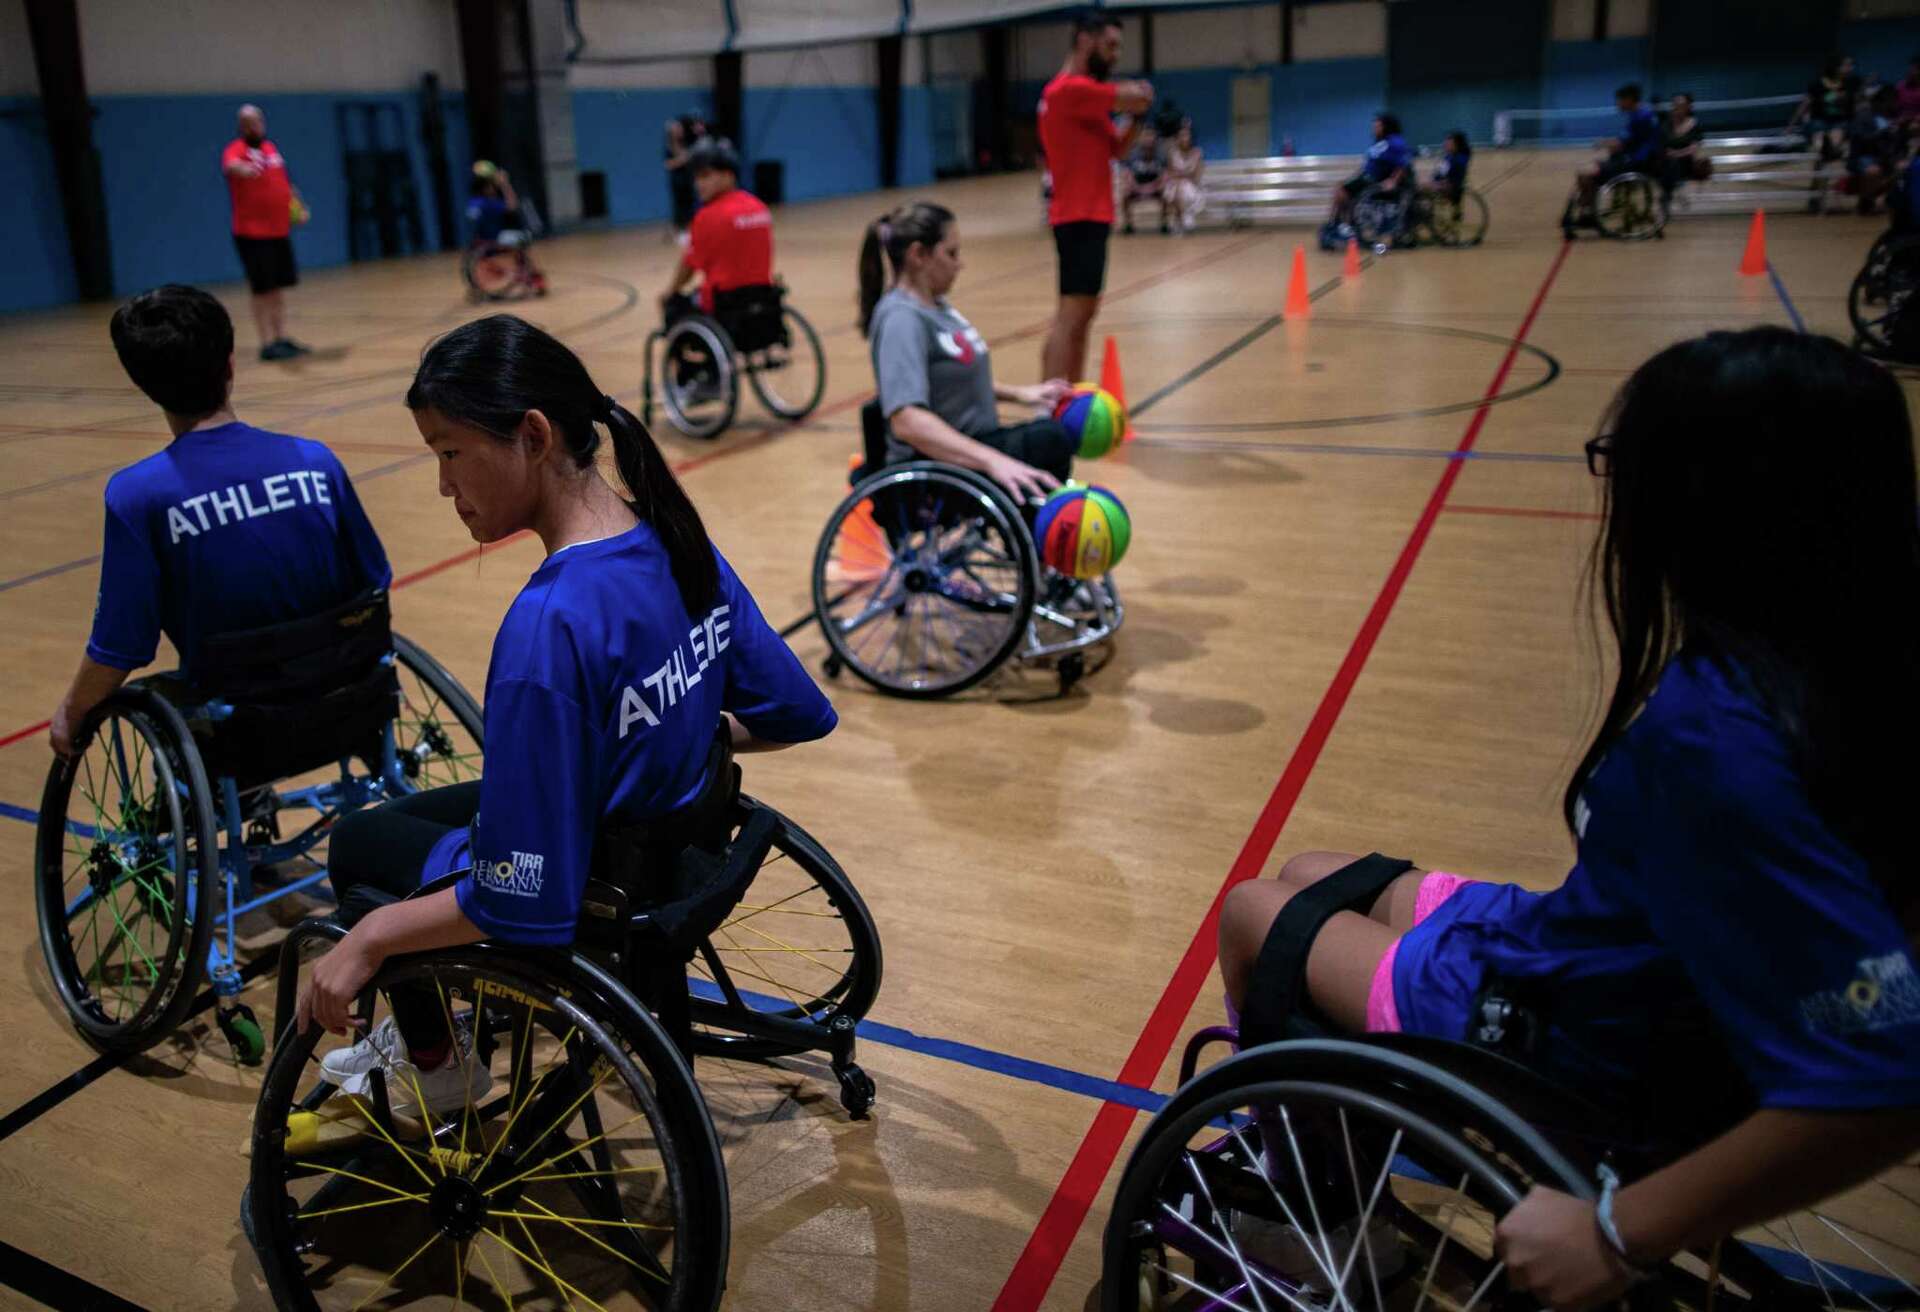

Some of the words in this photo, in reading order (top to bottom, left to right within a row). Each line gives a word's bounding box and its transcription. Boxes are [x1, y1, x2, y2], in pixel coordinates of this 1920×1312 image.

[167, 470, 332, 544] ATHLETE
[619, 604, 730, 739] ATHLETE
[511, 851, 544, 869] TIRR
